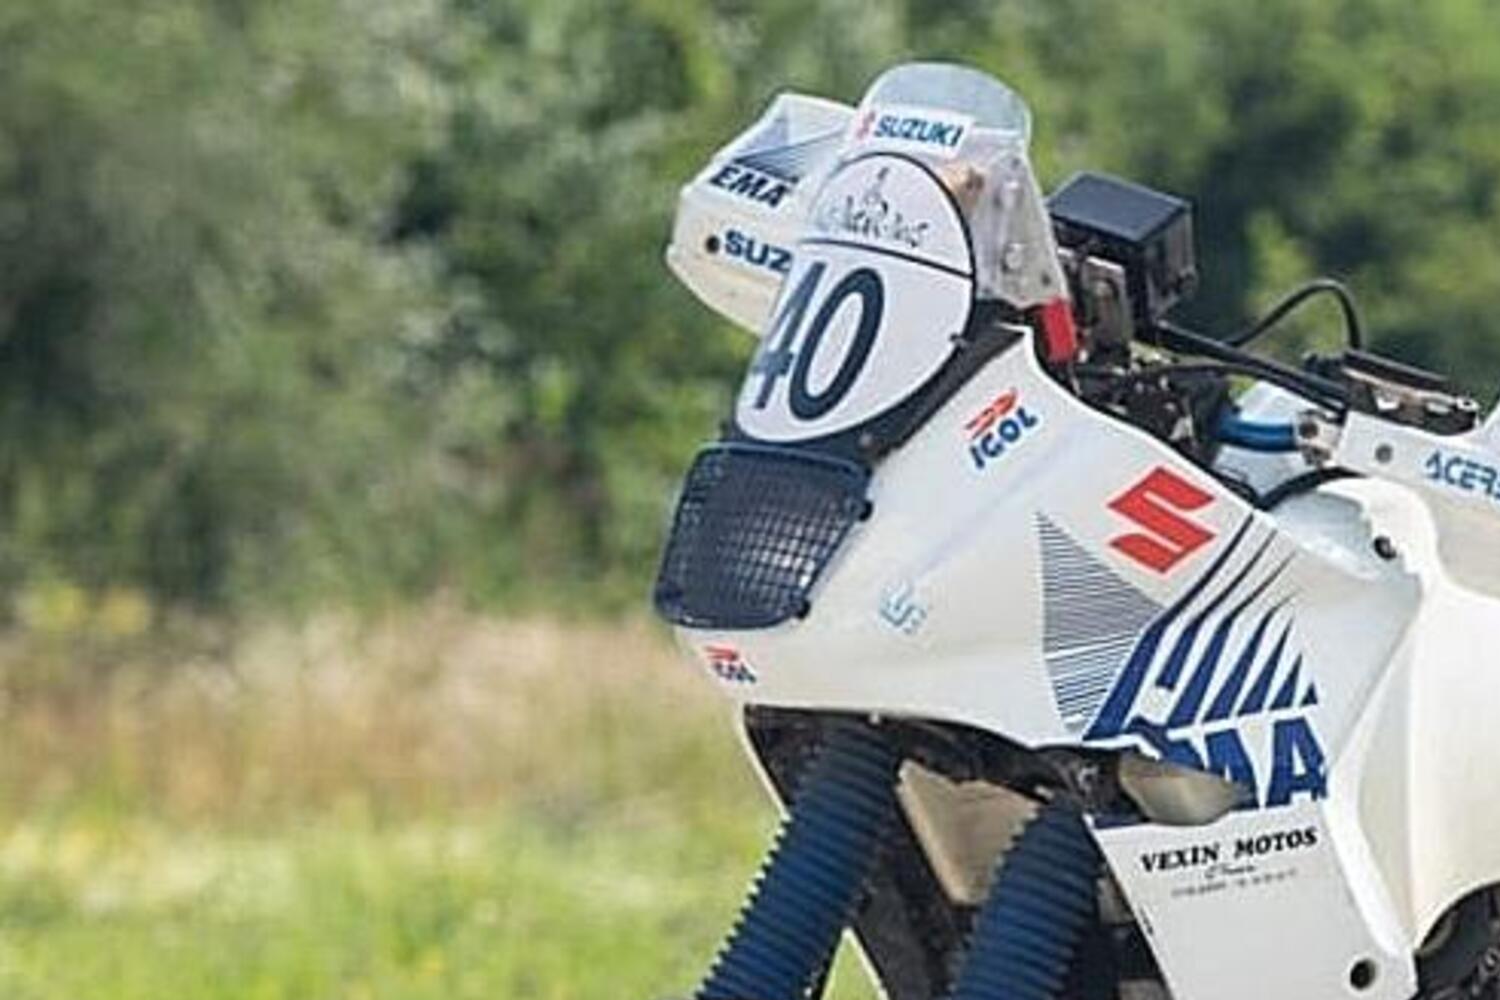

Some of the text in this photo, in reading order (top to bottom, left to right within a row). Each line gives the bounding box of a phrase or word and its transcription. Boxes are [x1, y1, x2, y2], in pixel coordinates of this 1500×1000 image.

[874, 114, 965, 149] SUZUKI
[710, 166, 787, 208] EMA
[753, 262, 885, 422] 40
[969, 405, 1038, 470] IGOL
[1141, 842, 1220, 872] VEXIN
[1233, 826, 1317, 859] MOTOS
